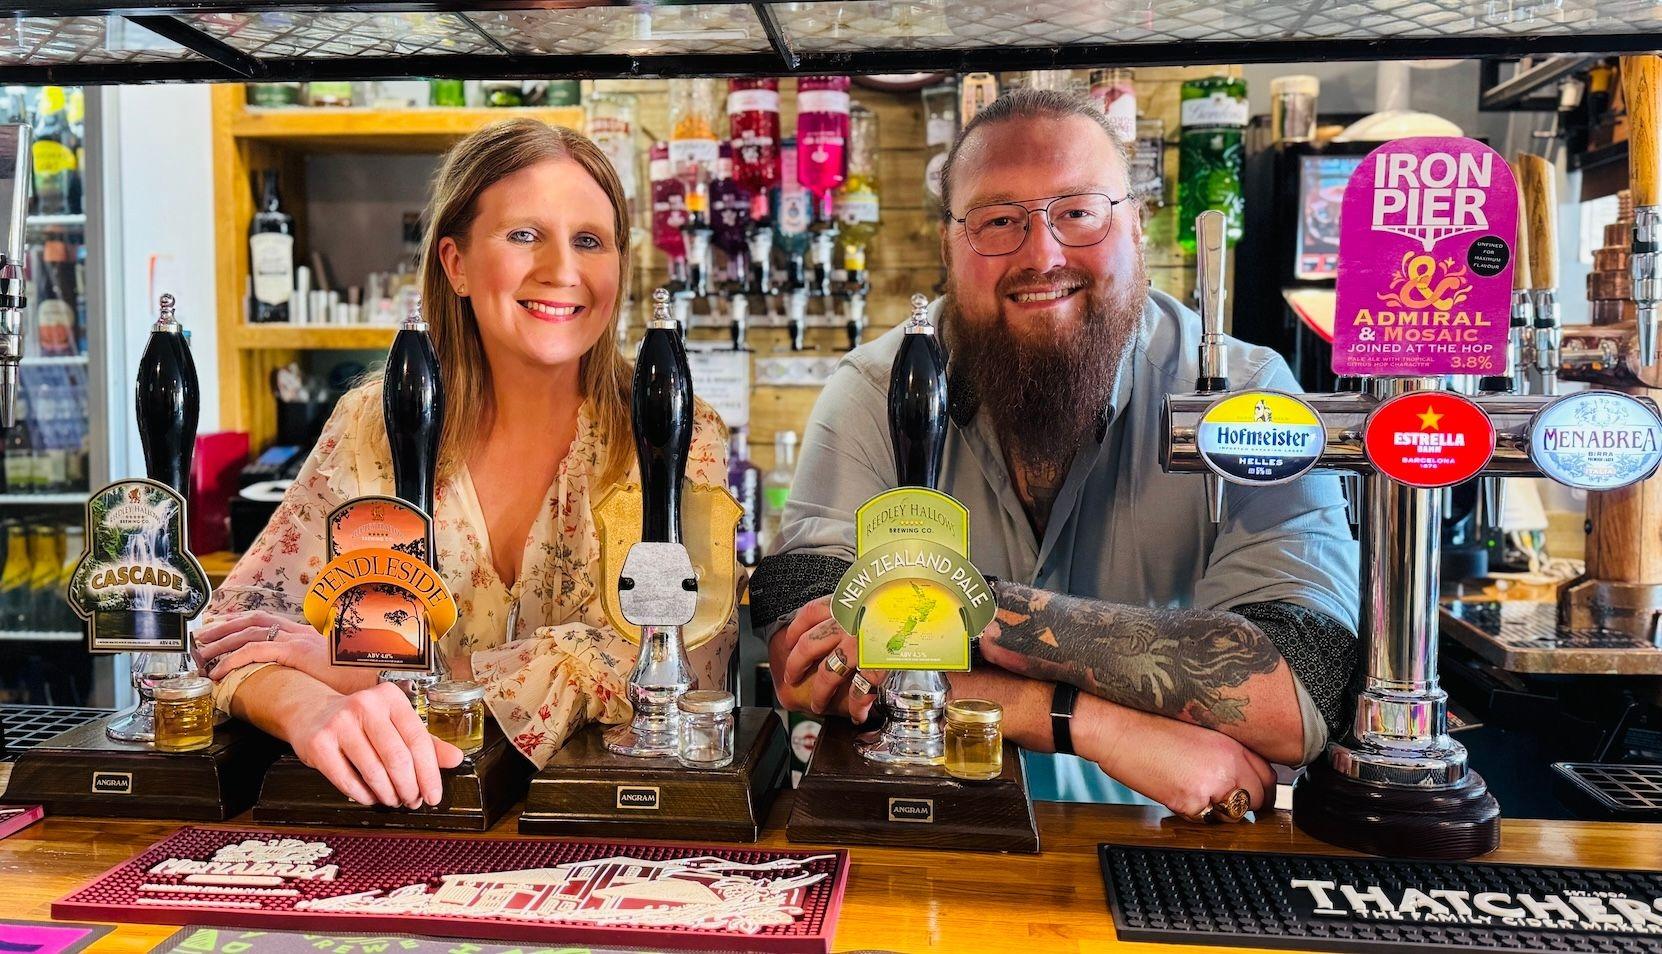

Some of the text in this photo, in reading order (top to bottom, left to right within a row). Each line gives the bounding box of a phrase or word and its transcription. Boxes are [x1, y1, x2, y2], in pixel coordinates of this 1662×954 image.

[1374, 152, 1493, 188] IRON
[1372, 188, 1488, 226] PIER
[1353, 309, 1491, 326] ADMIRAL
[1358, 327, 1479, 342] & MOSAIC
[1347, 344, 1493, 353] JOINED AT THE HOP
[1450, 356, 1493, 370] 3.8%
[1217, 427, 1310, 447] Hofmeister
[1394, 432, 1465, 446] ESTRELLA
[1544, 428, 1658, 452] MENABREA
[1239, 458, 1283, 466] HELLES
[867, 504, 907, 537] REEDLEY
[91, 565, 183, 592] CASCADE
[311, 556, 448, 606] PENDLESIDE
[839, 550, 989, 609] NEW ZEALAND PALE
[893, 806, 928, 814] ANGRAM
[149, 858, 339, 881] MENABREA
[1355, 909, 1403, 920] THE
[1410, 911, 1491, 925] FAMILY
[1502, 917, 1574, 929] CIDER
